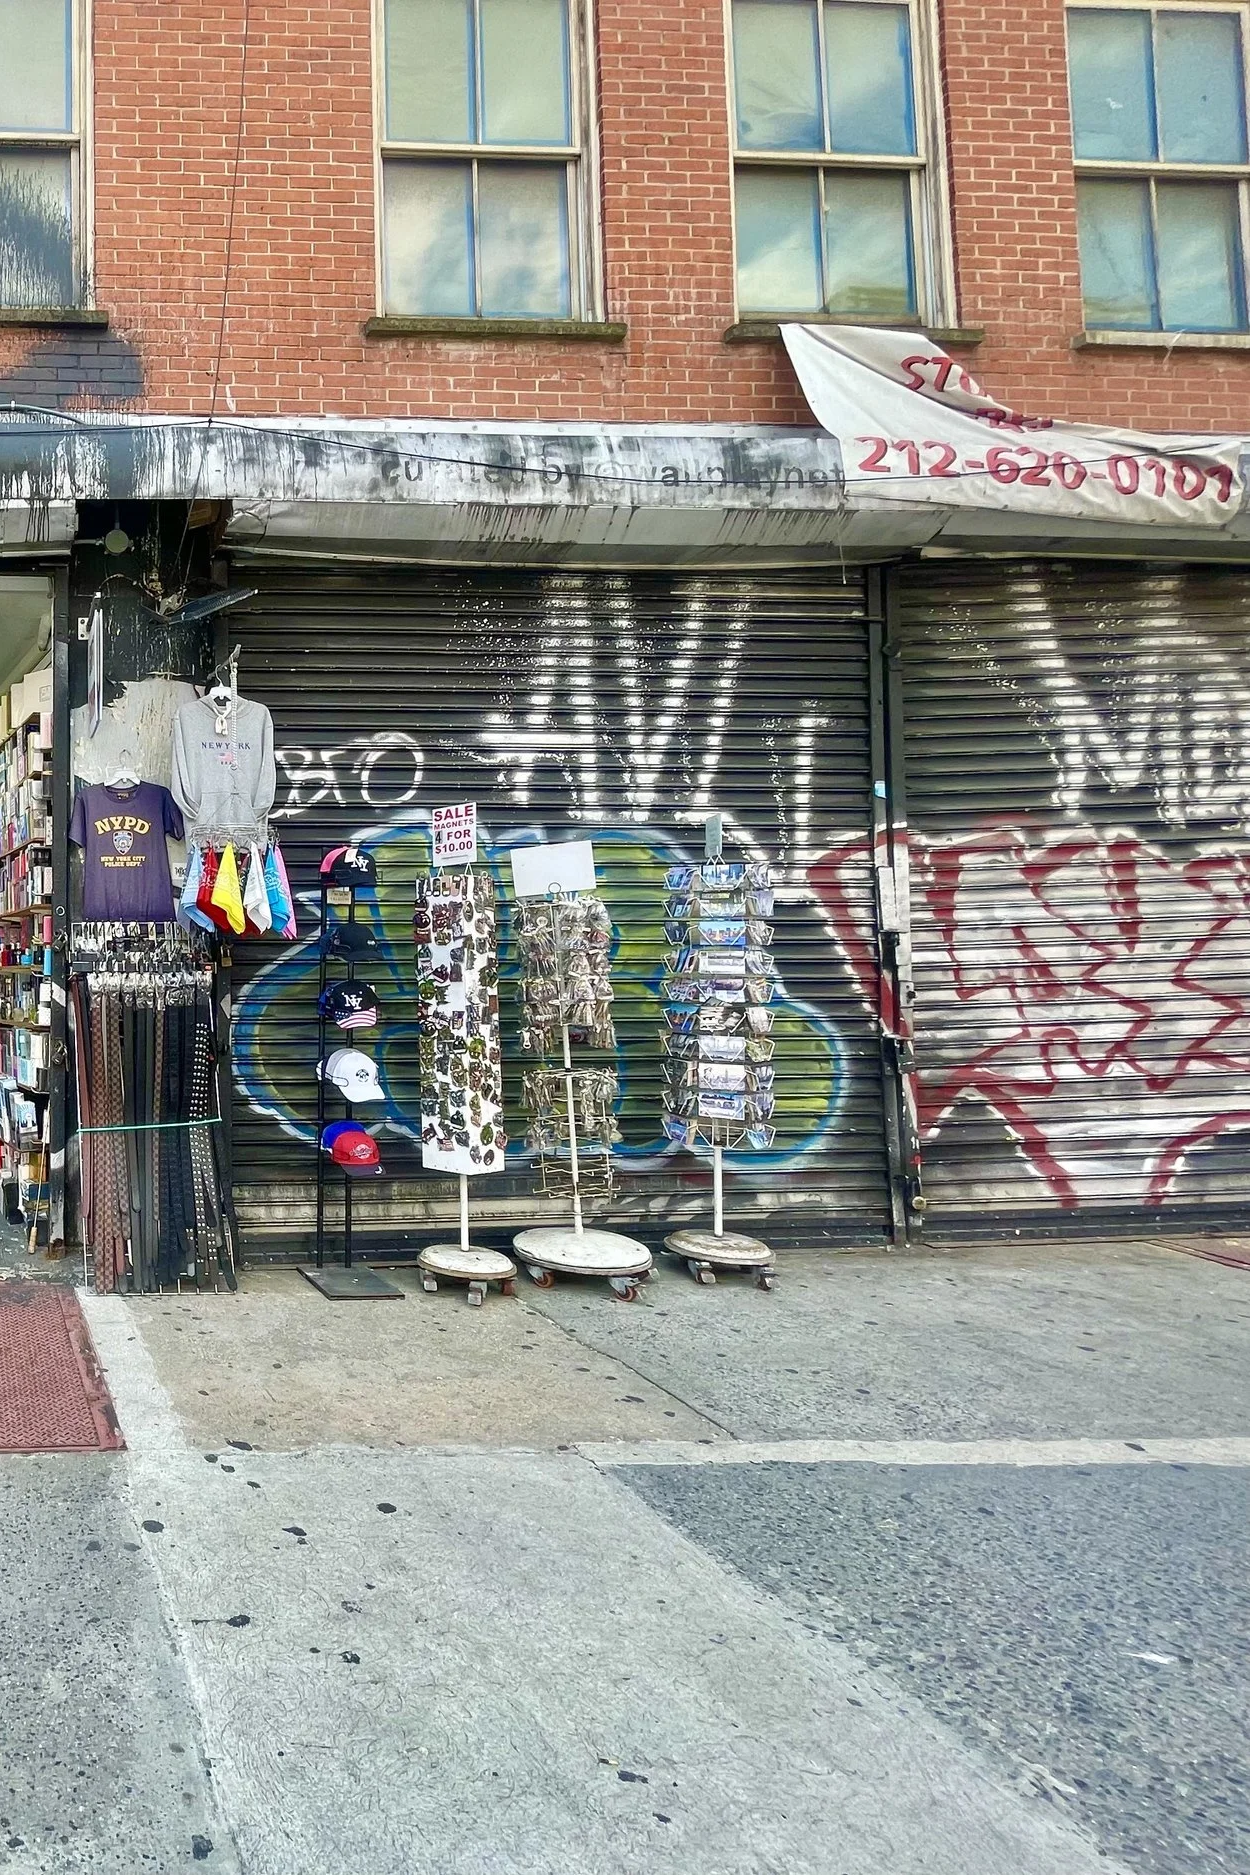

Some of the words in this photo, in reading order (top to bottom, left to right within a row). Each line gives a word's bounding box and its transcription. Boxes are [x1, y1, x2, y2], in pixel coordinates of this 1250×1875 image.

[854, 436, 1234, 502] 212-620-0101
[225, 742, 251, 750] YRK
[434, 805, 474, 822] SALE
[94, 816, 150, 835] NYPD
[434, 818, 474, 830] MAGNETS
[435, 831, 442, 844] 4
[447, 829, 471, 841] FOR
[435, 841, 473, 855] $10.00
[350, 856, 370, 872] NY
[344, 994, 363, 1010] NY
